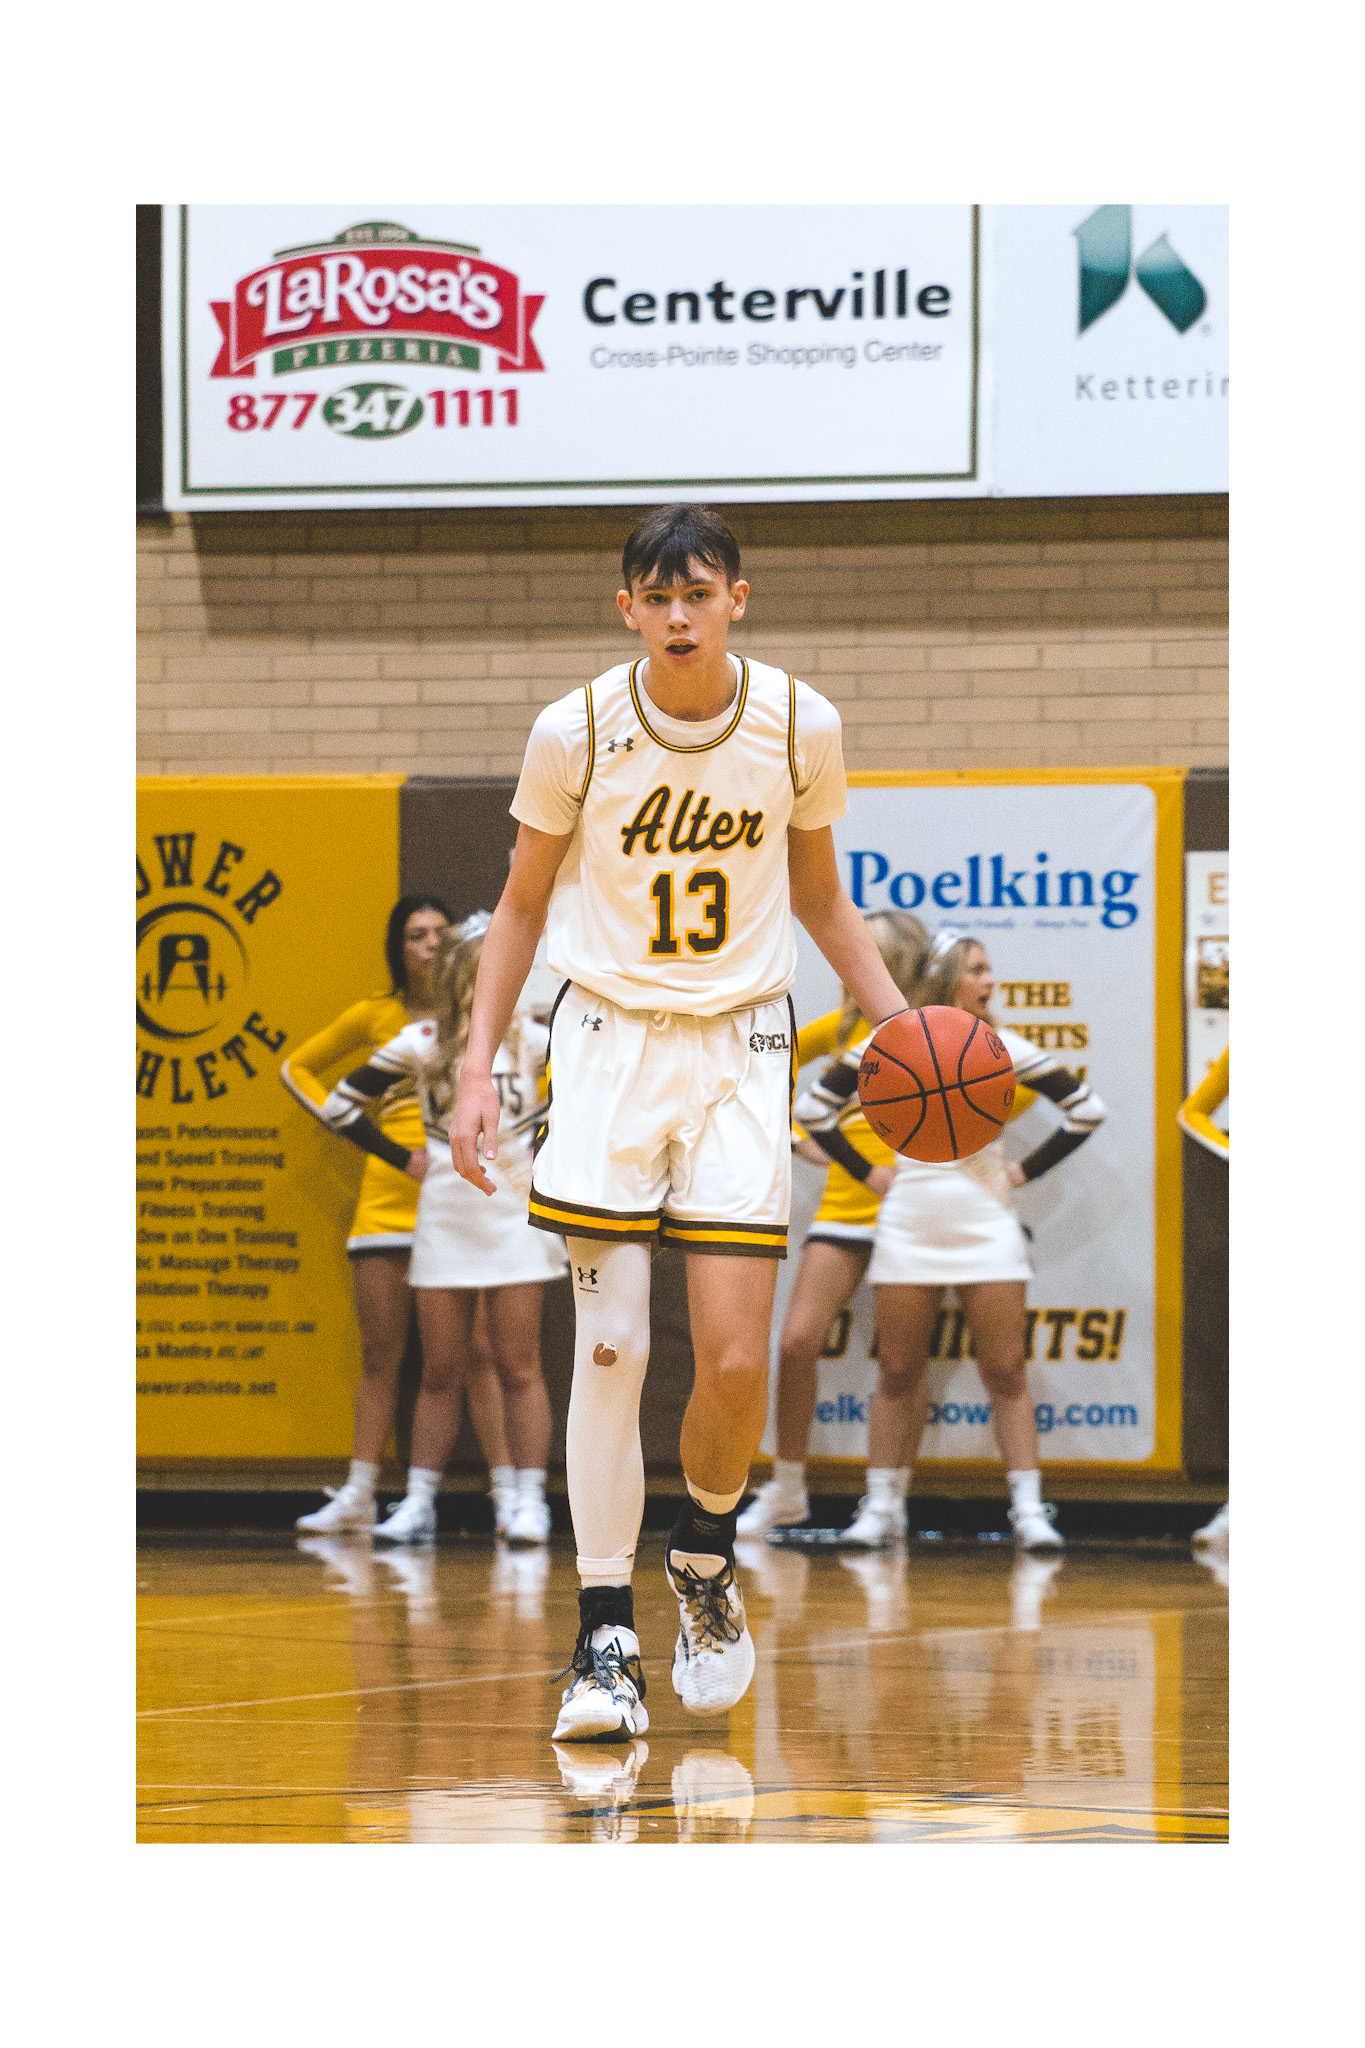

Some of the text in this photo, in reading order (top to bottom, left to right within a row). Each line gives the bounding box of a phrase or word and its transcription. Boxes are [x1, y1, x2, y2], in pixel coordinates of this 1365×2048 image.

[582, 267, 952, 326] Centerville
[292, 339, 464, 369] PIZZERIA
[589, 338, 944, 370] Cross-Pointe Shopping Center
[226, 387, 519, 436] 877 347 1111
[620, 784, 764, 856] Alter
[846, 851, 1141, 930] Poelking
[648, 867, 730, 957] 13
[1000, 981, 1072, 1008] THE
[765, 1033, 790, 1051] GCL
[177, 1122, 279, 1141] Performance
[165, 1149, 215, 1168] Speed
[221, 1149, 285, 1169] Training
[171, 1175, 264, 1194] Preparation
[140, 1201, 266, 1223] Fitness Training
[137, 1226, 298, 1248] One on One Training
[159, 1254, 231, 1275] Massage
[237, 1253, 300, 1275] Therapy
[207, 1279, 270, 1300] Therapy
